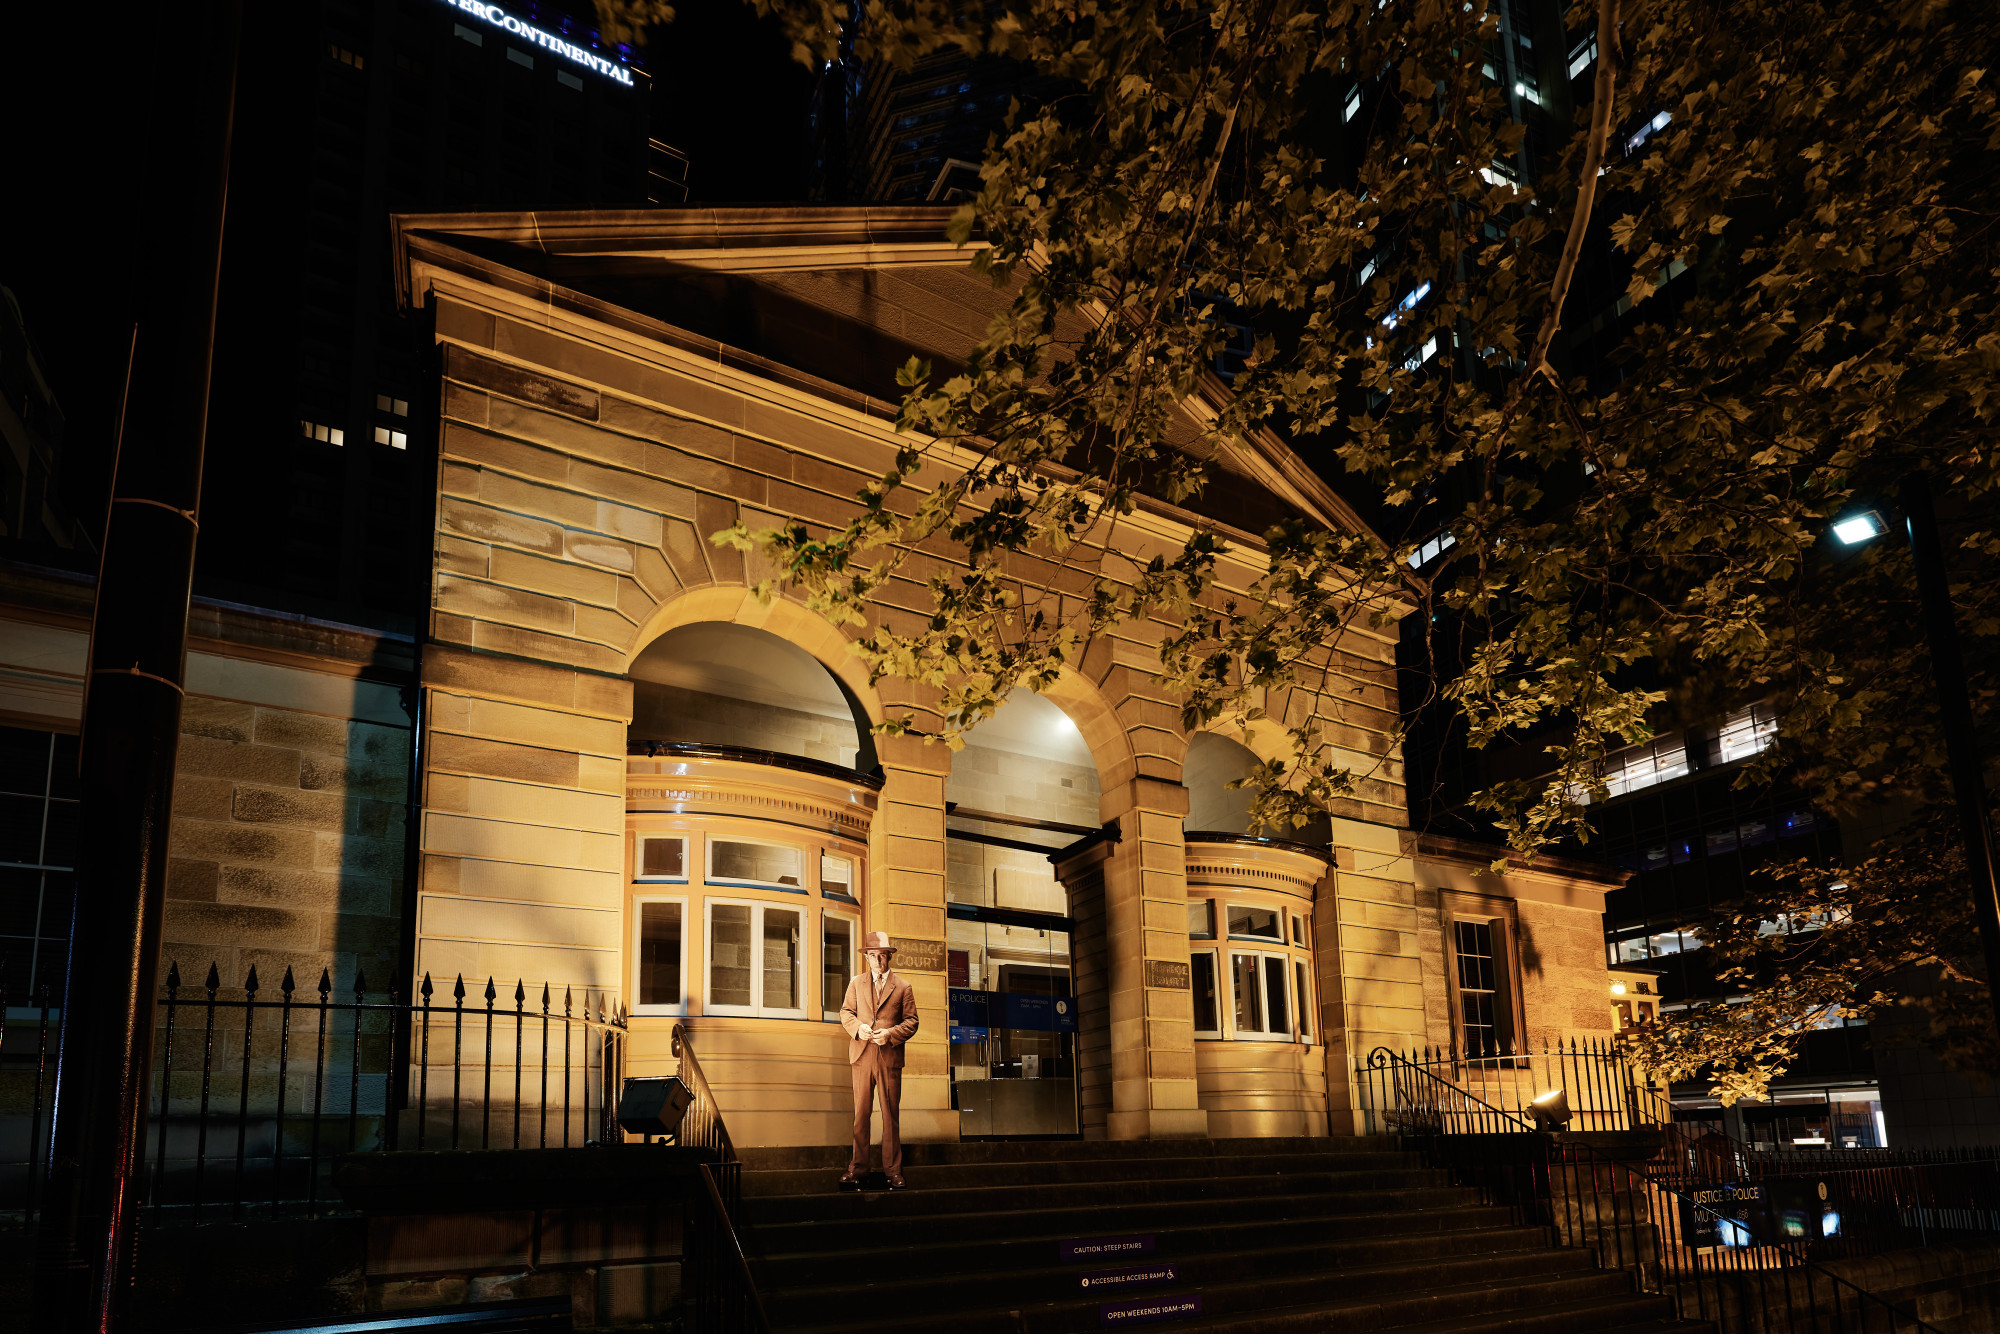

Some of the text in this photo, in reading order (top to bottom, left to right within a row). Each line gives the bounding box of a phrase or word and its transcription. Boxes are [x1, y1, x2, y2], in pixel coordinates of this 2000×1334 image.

[896, 954, 939, 968] COURT
[959, 994, 987, 1003] POLICE
[1732, 1187, 1759, 1201] POLICE
[1073, 1242, 1142, 1254] CAUTION: STEEP STAIRS
[1091, 1271, 1166, 1285] ACCESSIBLE ACCESS RAMP
[1107, 1311, 1126, 1320] OPEN
[1126, 1306, 1161, 1318] WEEKENDS
